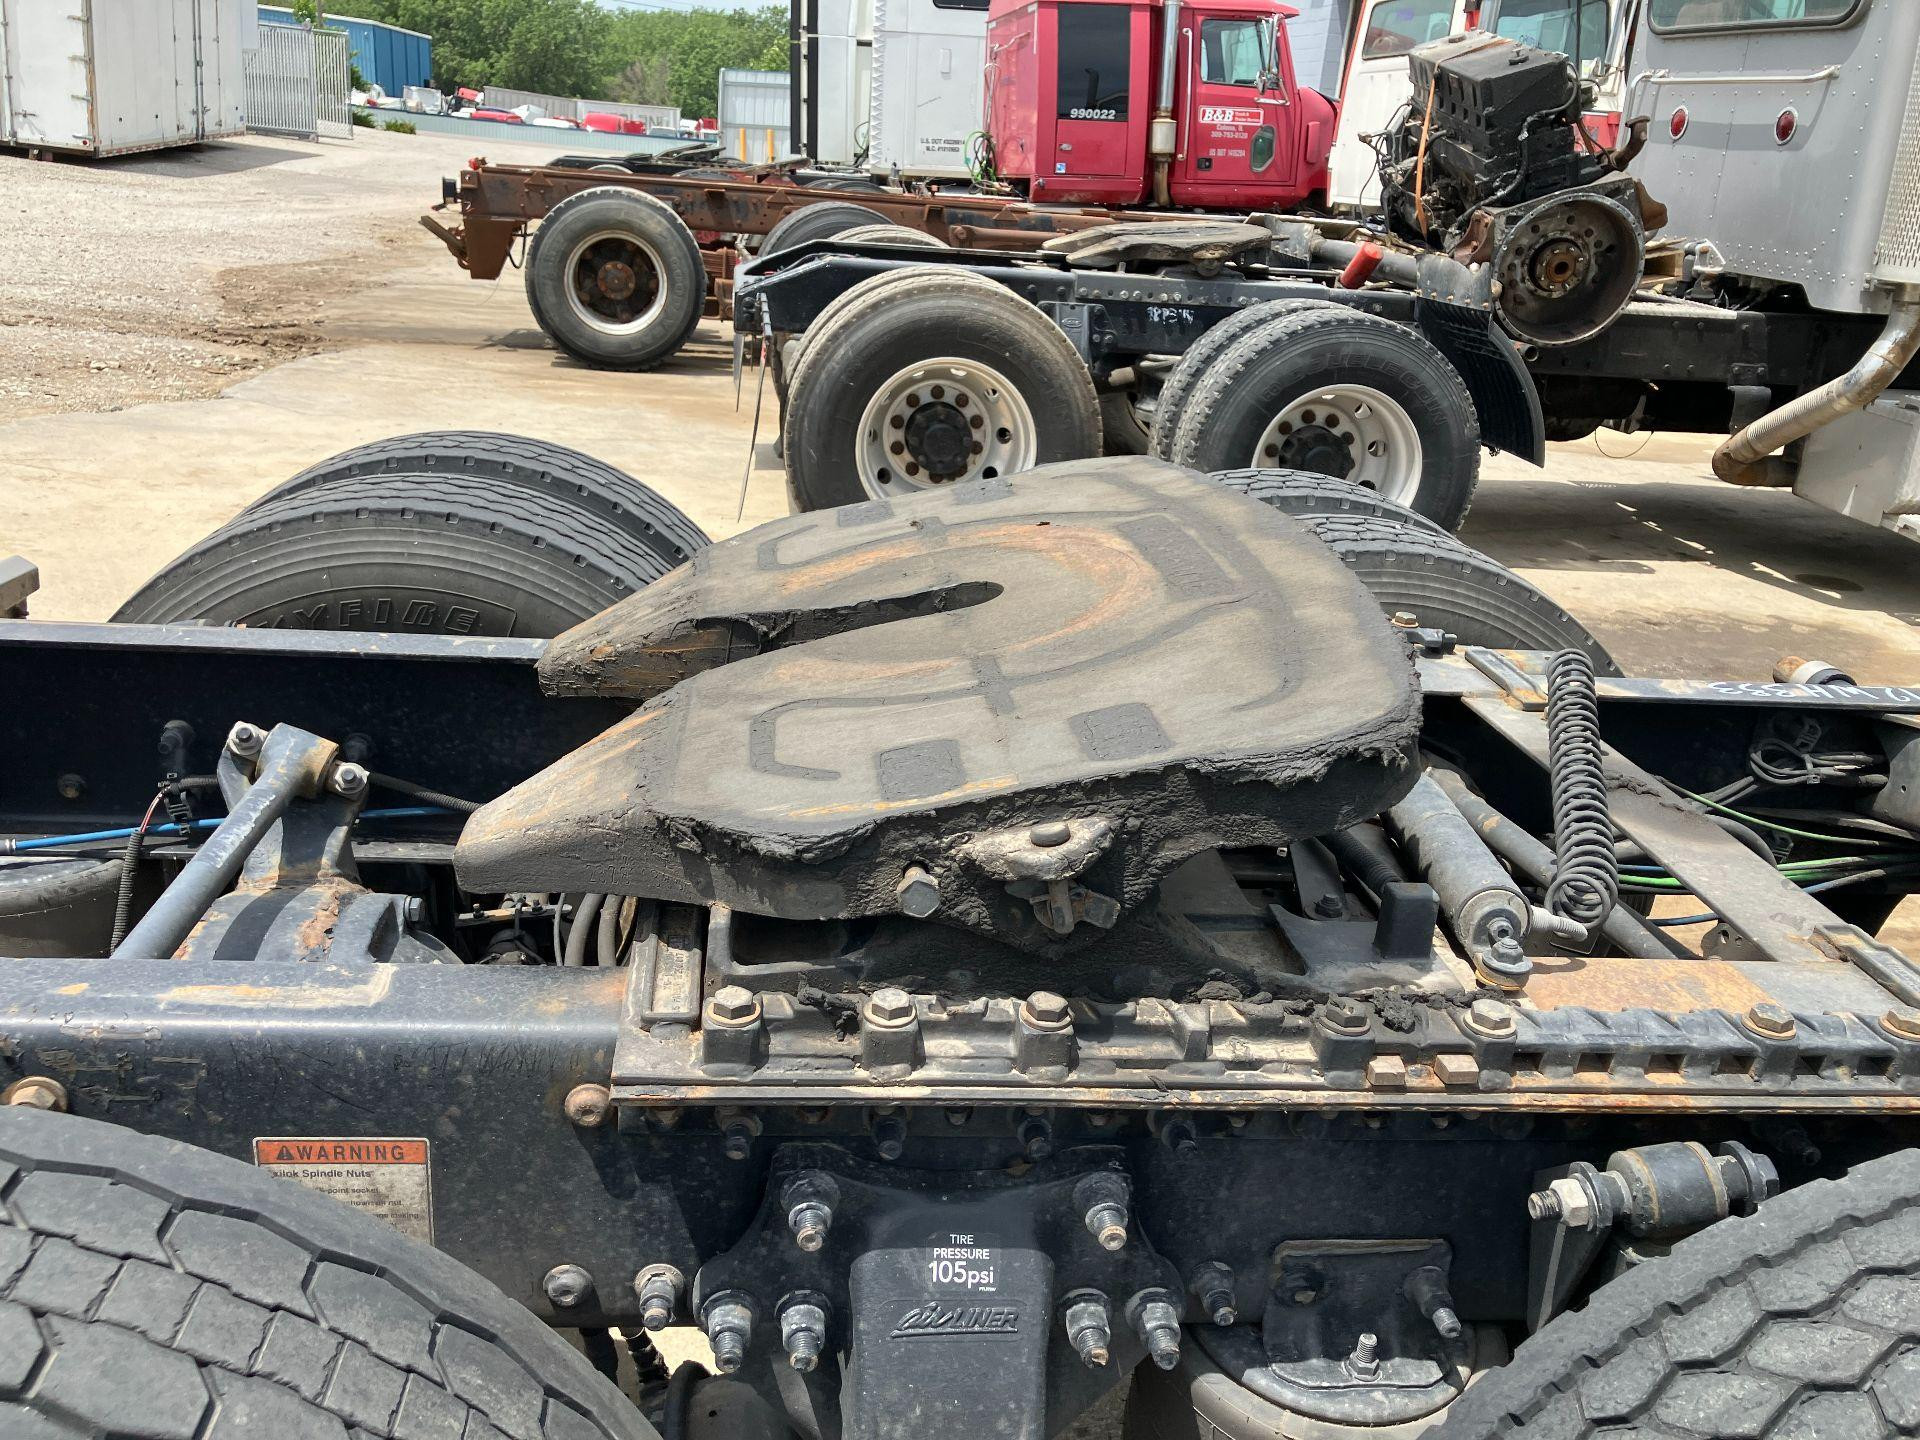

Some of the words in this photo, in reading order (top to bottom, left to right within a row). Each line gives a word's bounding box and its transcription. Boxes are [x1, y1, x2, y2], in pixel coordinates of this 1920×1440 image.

[1069, 108, 1116, 120] 990022
[1203, 108, 1234, 121] B&B
[256, 598, 479, 633] YFIRE
[296, 1145, 405, 1161] WARNING
[302, 1169, 344, 1180] Spindle
[346, 1169, 372, 1178] Nuts
[949, 1234, 974, 1245] TIRE
[933, 1248, 990, 1260] PRESSURE
[928, 1260, 994, 1289] 105psi
